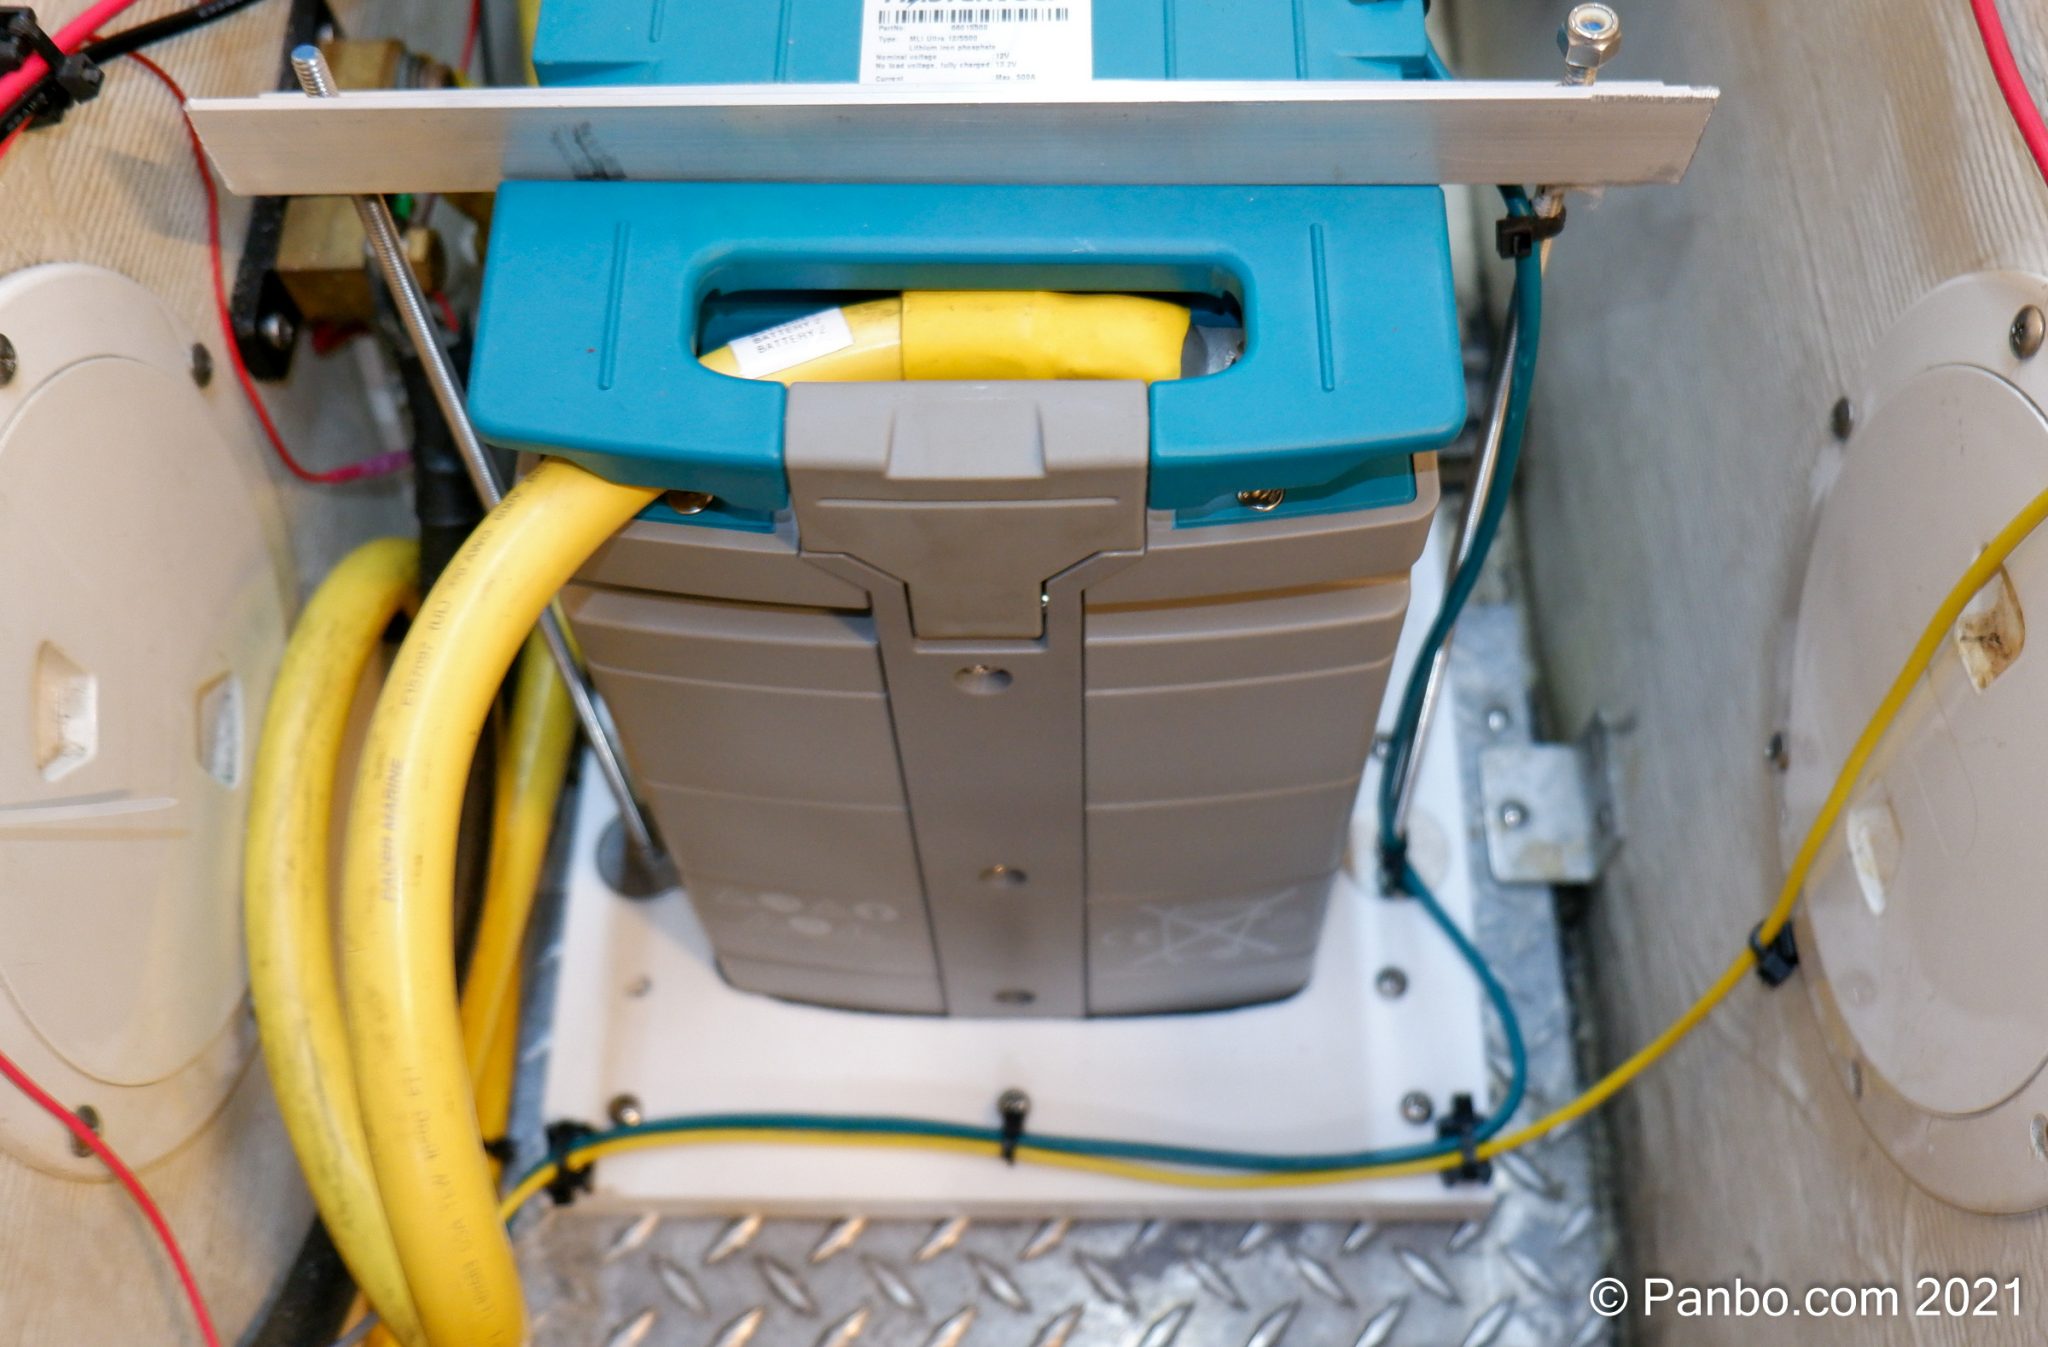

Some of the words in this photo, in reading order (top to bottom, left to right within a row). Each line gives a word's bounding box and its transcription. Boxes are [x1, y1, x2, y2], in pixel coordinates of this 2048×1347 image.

[909, 44, 938, 52] Lithium
[957, 43, 996, 52] phosphate
[909, 53, 937, 61] voltage
[941, 61, 957, 70] fully
[756, 329, 814, 354] BATTERY
